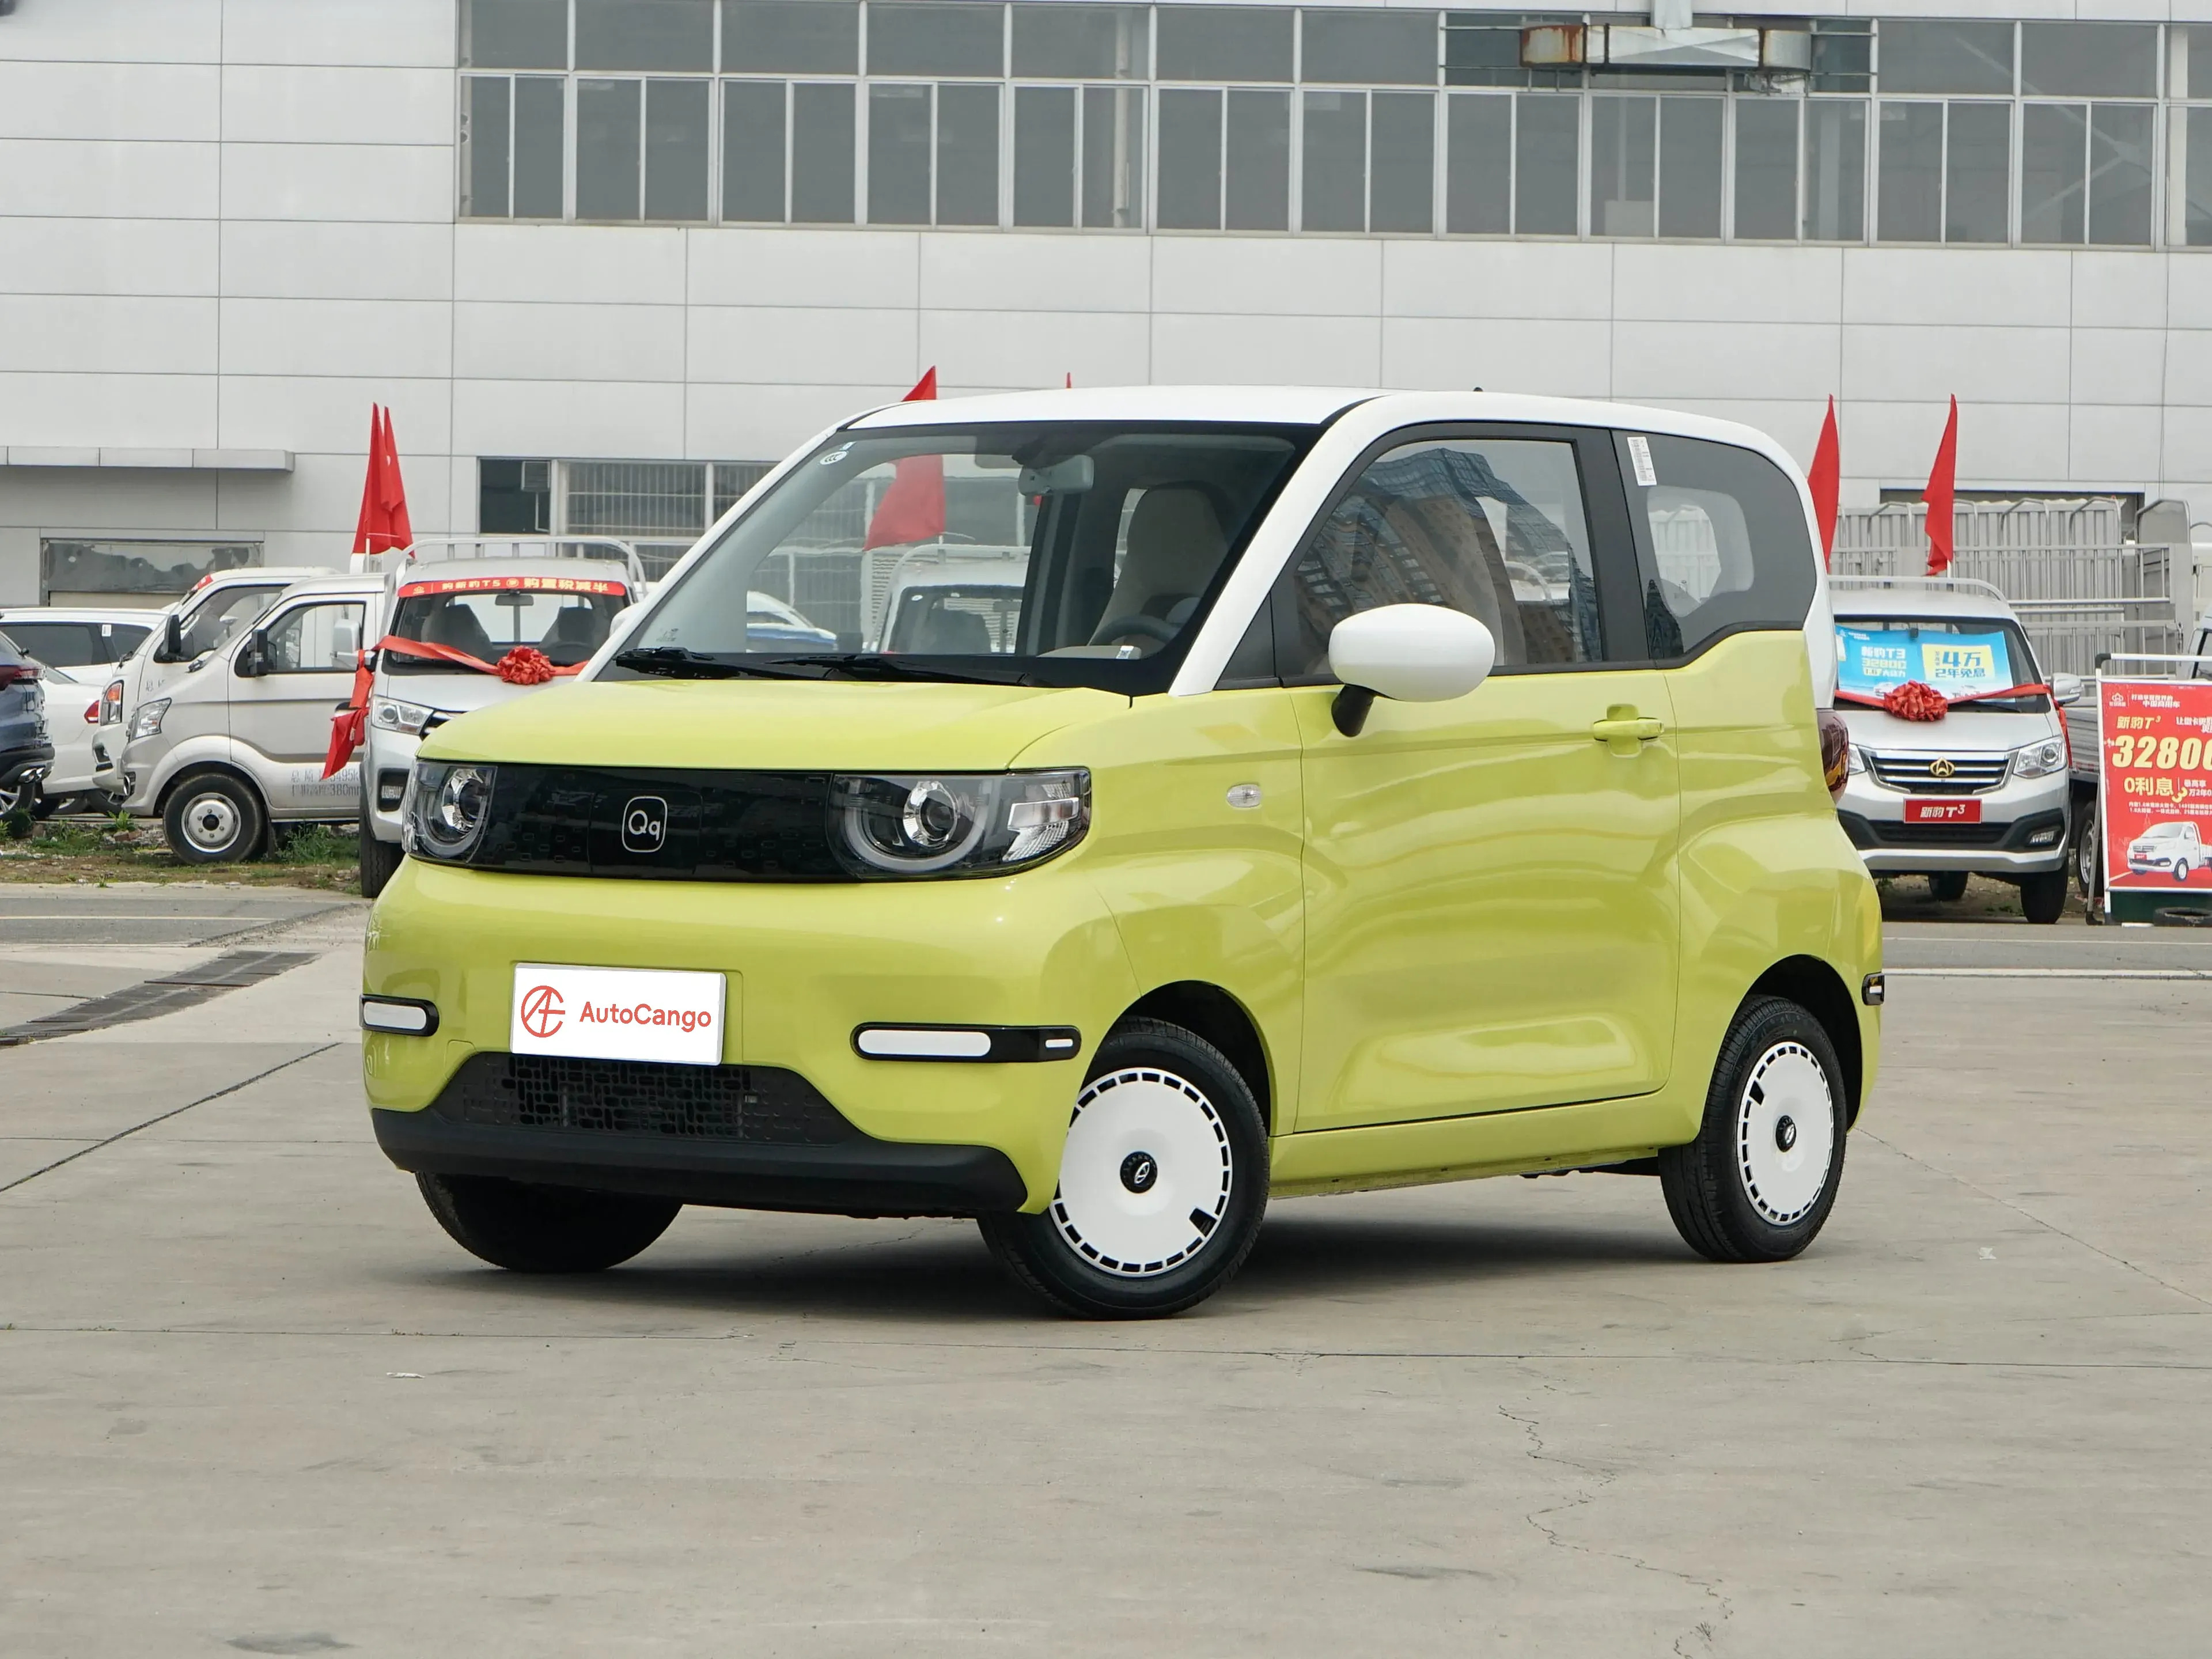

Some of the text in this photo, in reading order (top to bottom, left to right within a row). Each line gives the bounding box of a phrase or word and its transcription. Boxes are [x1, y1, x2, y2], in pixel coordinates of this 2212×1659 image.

[524, 578, 609, 593] 购置税减半
[1942, 652, 1981, 667] 4万
[1935, 668, 1986, 677] 2年免息
[2124, 777, 2174, 796] 0利息
[1920, 804, 1966, 818] 新豹T3
